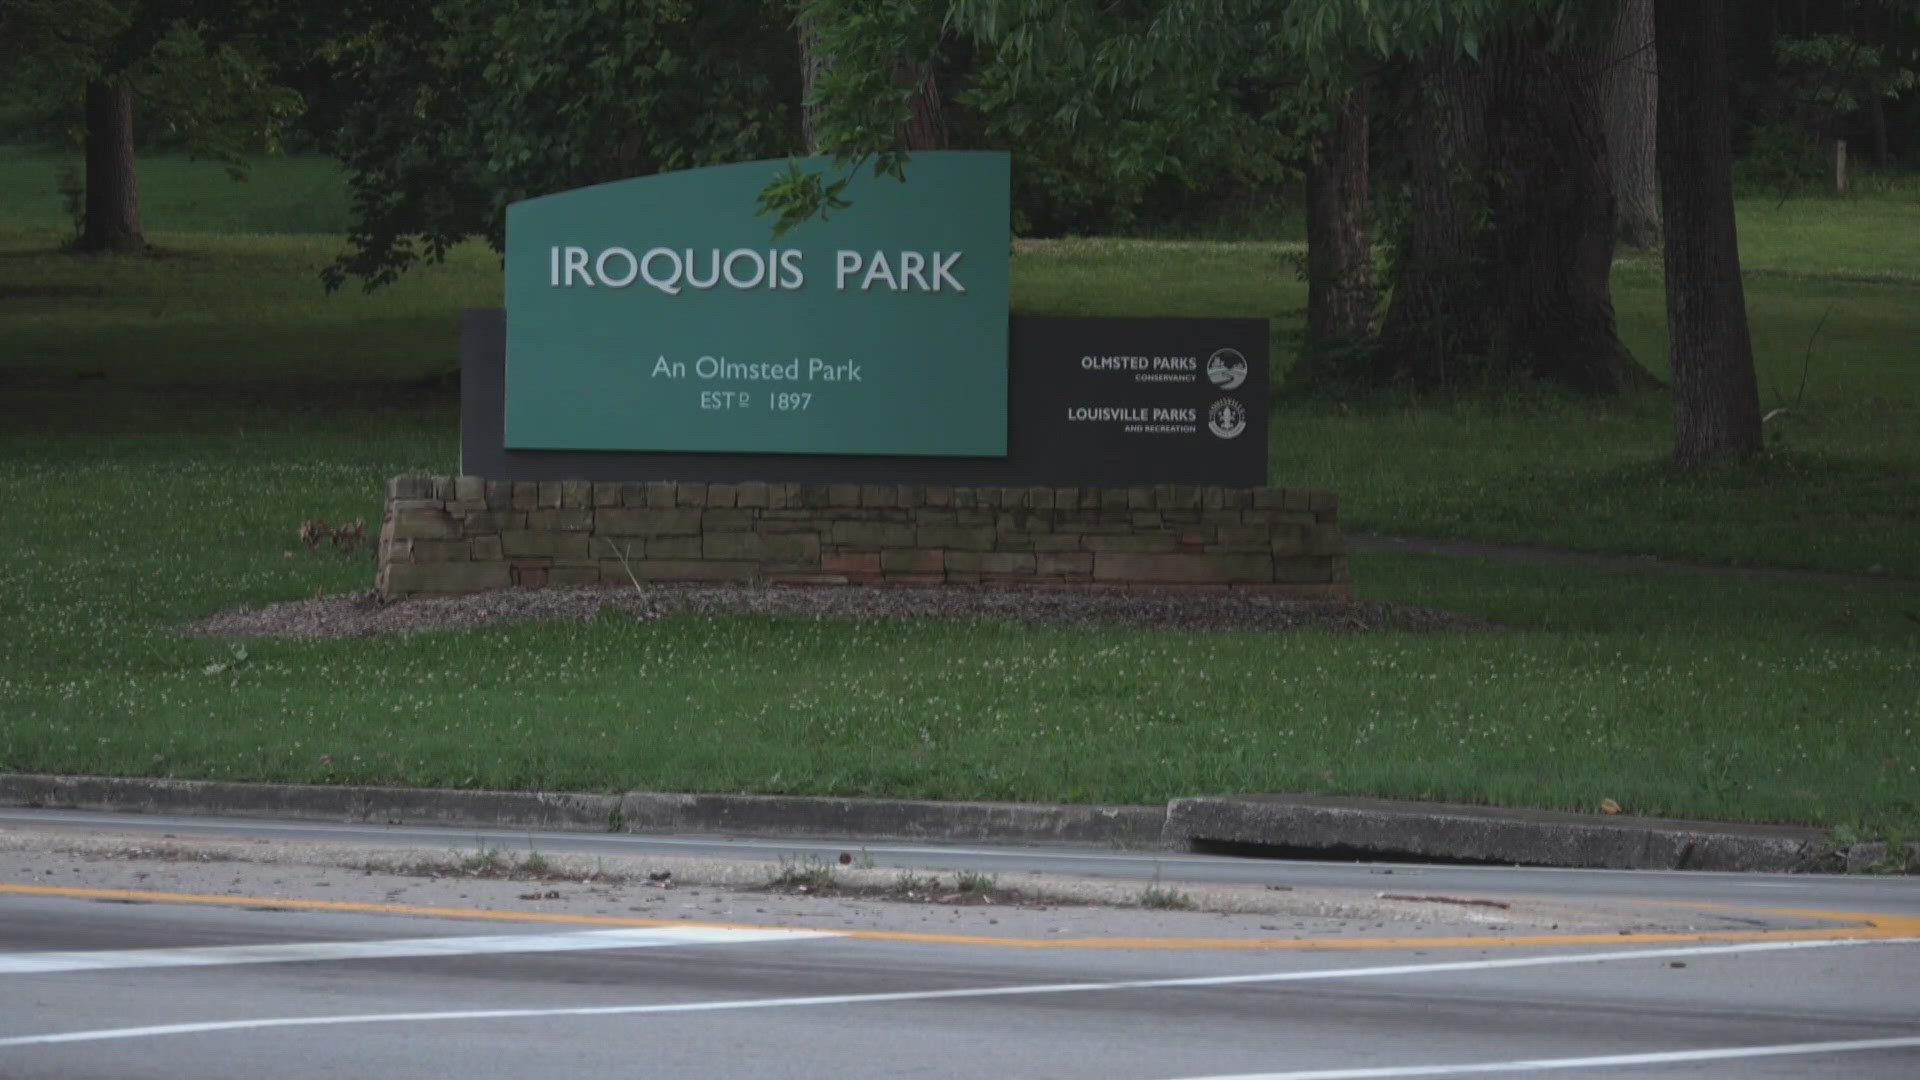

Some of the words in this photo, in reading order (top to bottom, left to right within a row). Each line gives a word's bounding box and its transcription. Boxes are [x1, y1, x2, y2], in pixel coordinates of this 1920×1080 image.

[551, 246, 804, 295] IROQUOIS
[836, 249, 967, 292] PARK
[651, 355, 686, 379] An
[695, 356, 799, 381] Olmsted
[809, 358, 862, 381] Park
[1081, 355, 1149, 370] OLMSTED
[1153, 356, 1197, 370] PARKS
[1134, 374, 1196, 383] CONSERVANCY
[770, 393, 812, 411] 1897
[1068, 407, 1148, 422] LOUISVILLE
[1153, 408, 1197, 422] PARKS
[1124, 424, 1143, 433] AND
[1145, 424, 1196, 433] RECREATION
